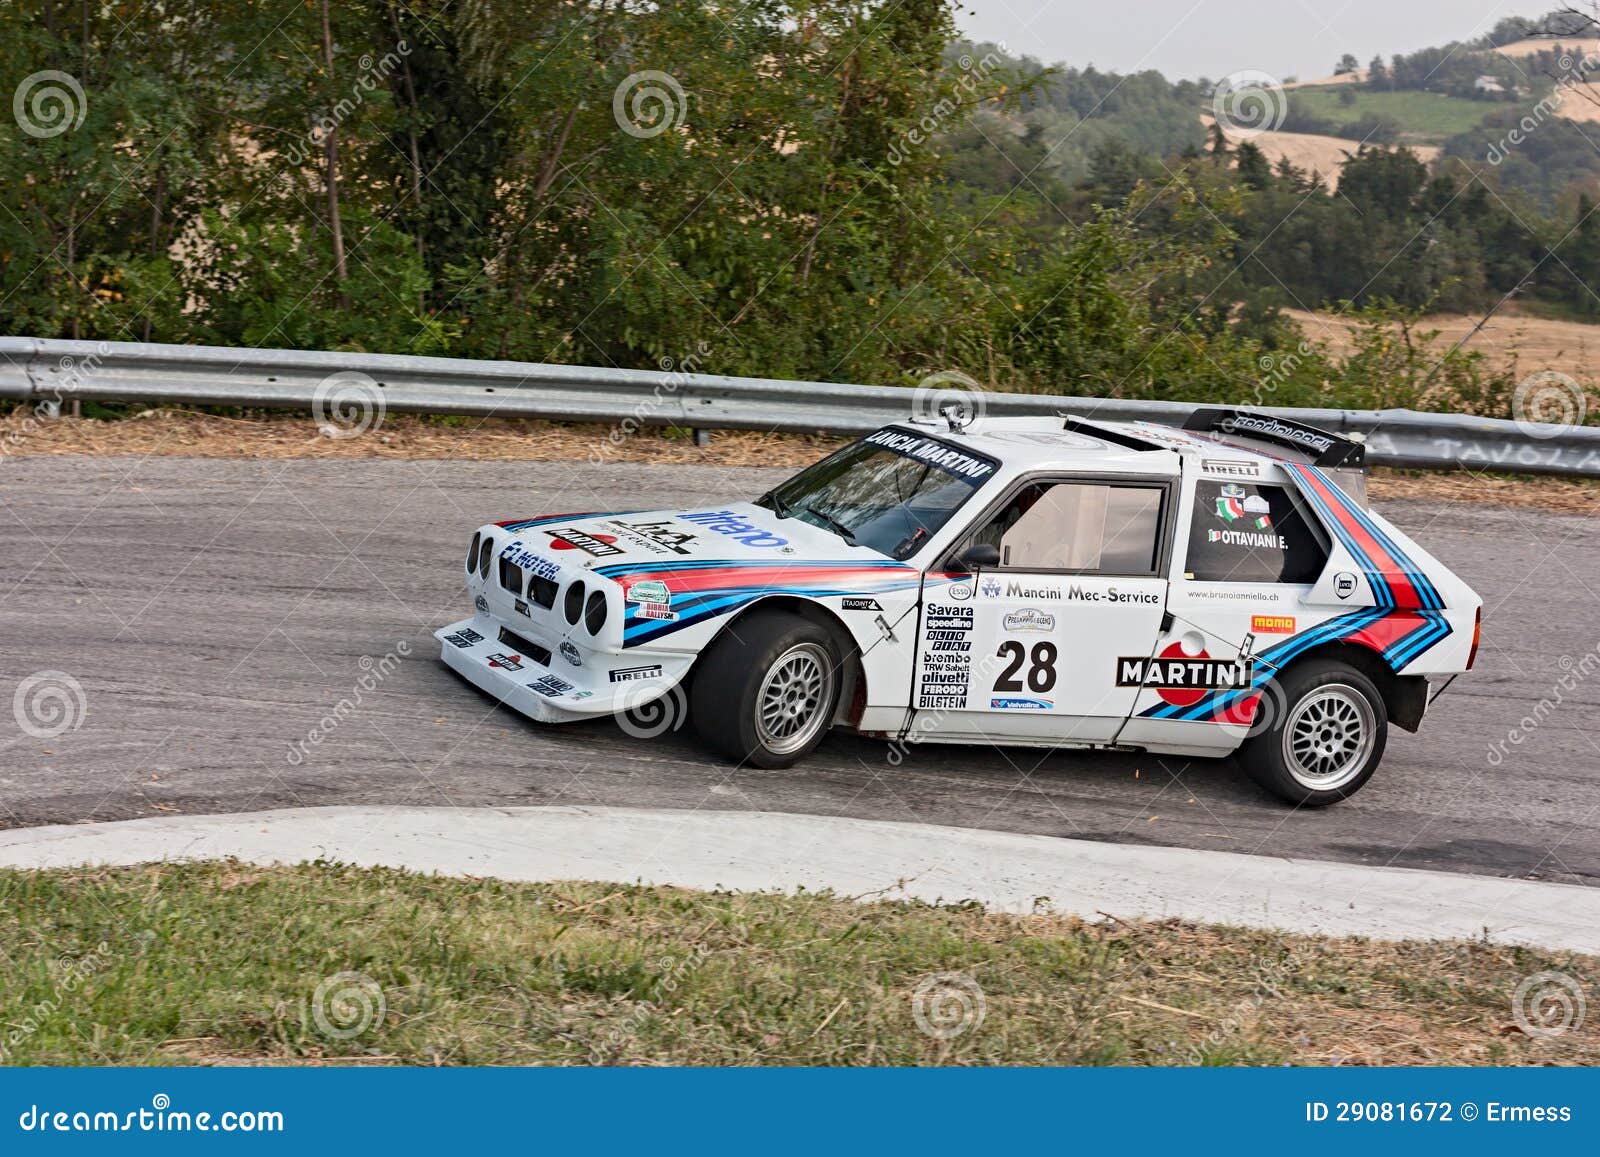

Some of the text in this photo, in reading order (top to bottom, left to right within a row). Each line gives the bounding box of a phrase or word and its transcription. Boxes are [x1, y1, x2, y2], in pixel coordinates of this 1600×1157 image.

[864, 430, 992, 478] LANCIA MARTINI
[1201, 459, 1259, 477] PIRELLI
[550, 528, 620, 557] MARTINI
[1221, 530, 1277, 549] OTTAVIANI
[1006, 580, 1159, 604] Mancini Mec-Service
[927, 603, 974, 617] Savara
[927, 618, 972, 630] speedline
[926, 631, 965, 641] OLIO
[933, 642, 971, 651] FIAT
[923, 650, 971, 663] brembo
[609, 664, 663, 683] PIRELLI
[924, 664, 944, 672] TRW
[992, 640, 1058, 694] 28
[1121, 660, 1247, 686] MARTINI
[922, 672, 969, 683] olivetti
[923, 685, 965, 695] FERODO
[919, 697, 967, 708] BILSTEIN
